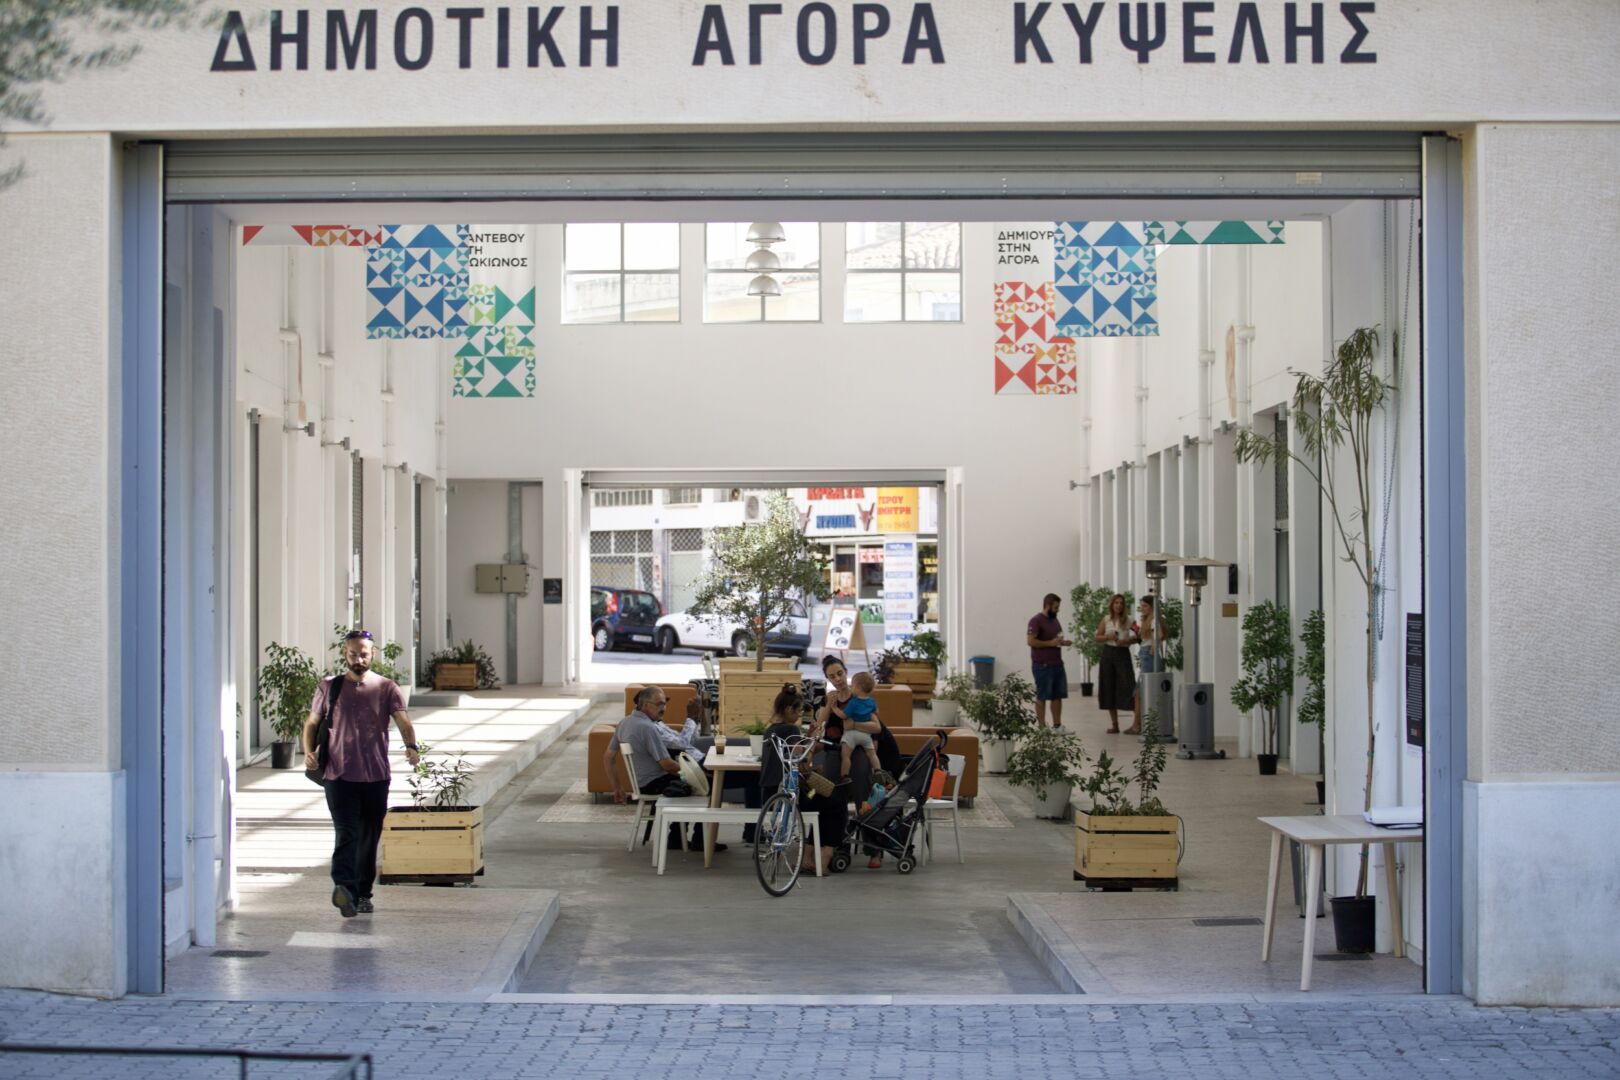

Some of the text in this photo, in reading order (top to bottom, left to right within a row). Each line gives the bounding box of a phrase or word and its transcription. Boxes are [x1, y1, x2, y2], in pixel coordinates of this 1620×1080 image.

[210, 2, 1378, 72] ΔΗΜΟΤΙΚΗ ΑΓΟΡΑ ΚΥΨΕΛΗΣ
[469, 233, 525, 243] ΑΝΤΕΒΟΥ
[998, 230, 1055, 240] ΔΗΜΙΟΥΡ
[469, 245, 483, 255] ΤΗ
[998, 243, 1031, 253] ΣΤΗΝ
[469, 257, 528, 267] ΩΚΙΩΝΟΣ
[998, 255, 1040, 265] ΑΓΟΡΑ
